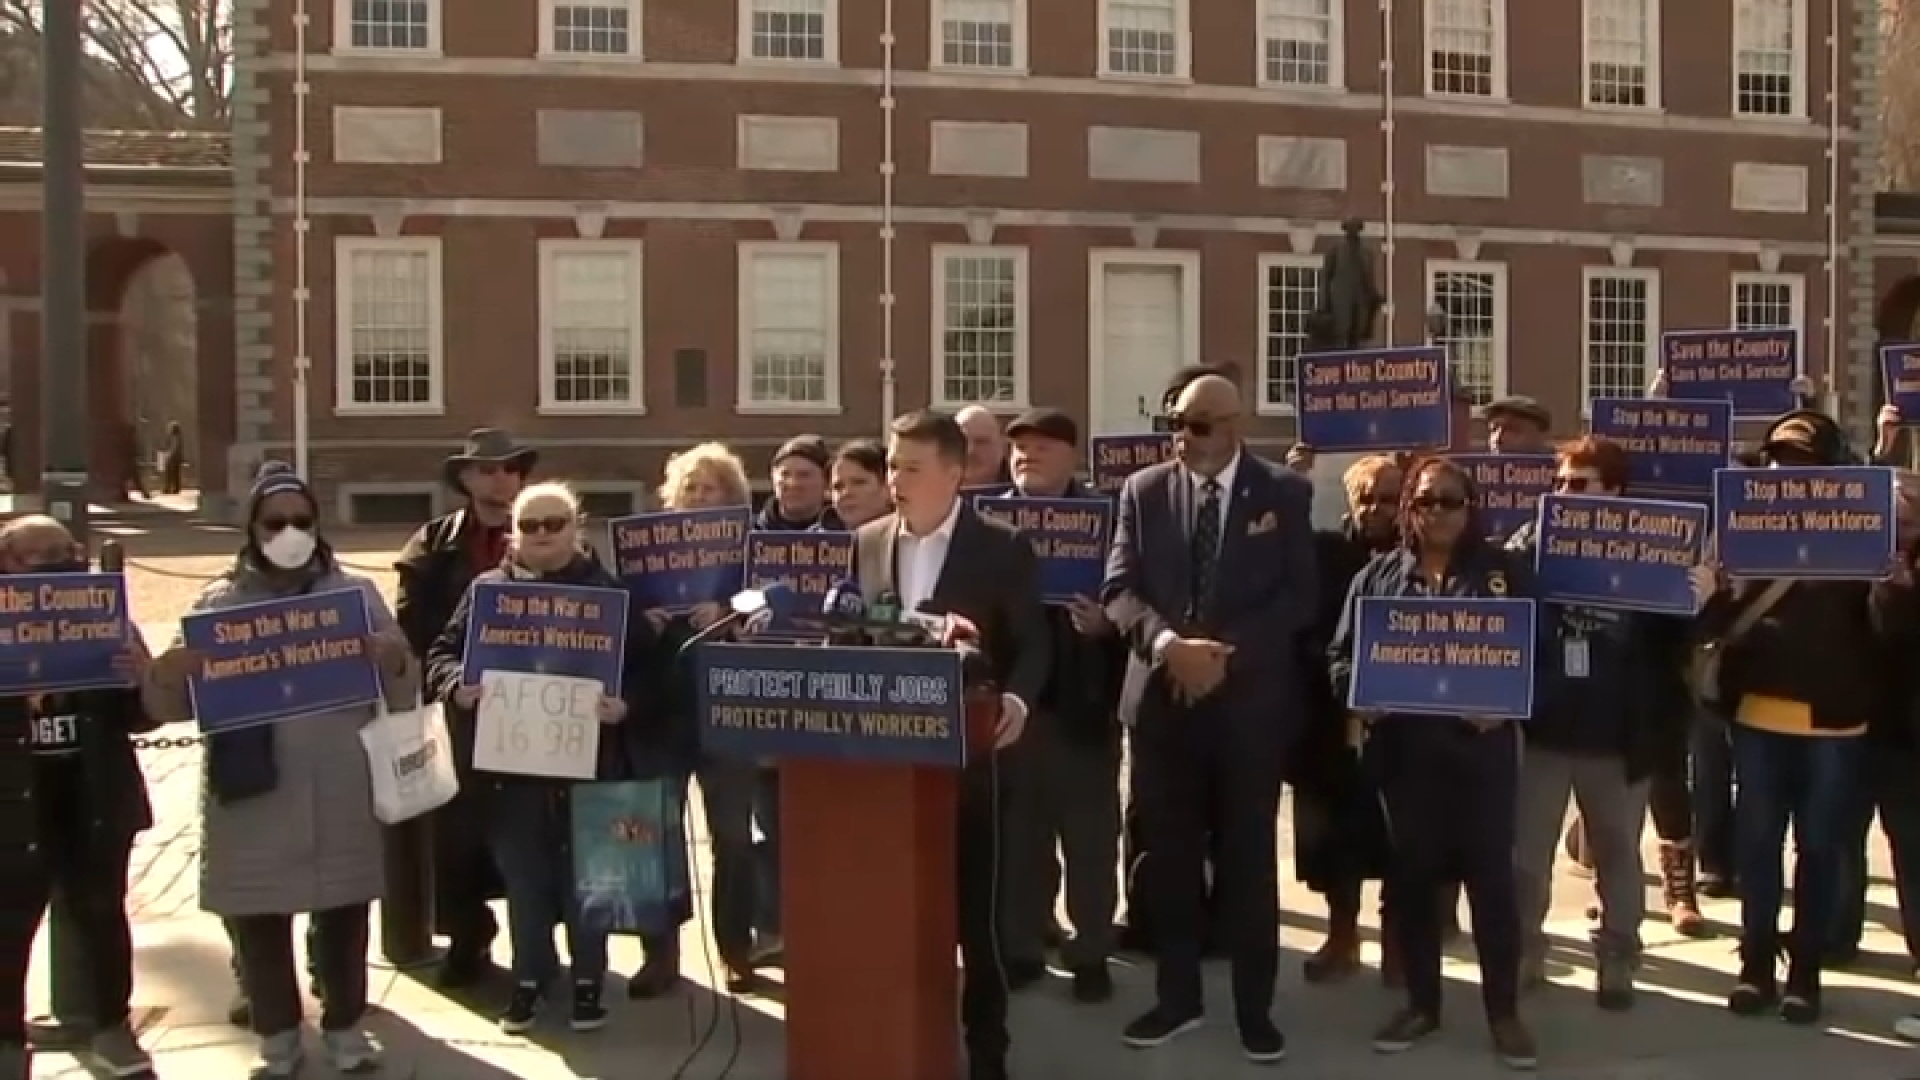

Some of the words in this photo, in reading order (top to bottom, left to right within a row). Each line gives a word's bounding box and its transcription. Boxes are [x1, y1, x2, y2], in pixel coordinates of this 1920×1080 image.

[1671, 340, 1702, 360] Save
[1706, 340, 1728, 358] the
[1732, 338, 1789, 360] Country
[1305, 362, 1340, 385] Save
[1346, 360, 1371, 382] the
[1375, 358, 1438, 383] Country
[1305, 393, 1332, 412] Save
[1336, 392, 1355, 410] the
[1359, 391, 1388, 408] Civil
[1389, 387, 1440, 408] Service!
[1612, 406, 1638, 428] Stop
[1642, 409, 1662, 427] the
[1666, 409, 1688, 427] War
[1692, 413, 1708, 428] on
[1099, 442, 1131, 464] Save
[1135, 443, 1157, 462] the
[1659, 436, 1721, 454] Workforce
[1476, 462, 1499, 484] the
[1743, 479, 1777, 503] Stop
[1781, 479, 1805, 499] the
[1810, 479, 1840, 499] War
[1845, 482, 1864, 499] on
[1017, 508, 1040, 529] the
[1043, 507, 1101, 538] Country
[1551, 503, 1589, 529] Save
[1596, 507, 1623, 531] the
[1628, 509, 1697, 544] Country
[1728, 509, 1797, 531] America's
[1803, 509, 1882, 531] Workforce
[619, 525, 649, 549] Save
[653, 522, 678, 544] the
[682, 518, 743, 544] Country
[668, 550, 696, 570] Civil
[699, 547, 743, 568] Service
[754, 541, 787, 565] Save
[792, 541, 814, 565] the
[1547, 535, 1577, 556] Save
[1581, 537, 1603, 558] the
[1607, 539, 1635, 561] Civil
[1639, 543, 1693, 568] Service!
[802, 573, 827, 593] Civil
[40, 584, 115, 614] Country
[496, 594, 522, 618] Stop
[527, 596, 549, 616] the
[552, 597, 580, 618] War
[583, 602, 599, 620] on
[18, 621, 54, 643] Civil
[58, 617, 121, 642] Service!
[213, 619, 252, 646] Stop
[256, 613, 282, 636] the
[285, 609, 316, 633] War
[320, 606, 339, 626] on
[1388, 609, 1421, 635] Stop
[1425, 609, 1448, 632] the
[1452, 608, 1482, 632] War
[1487, 615, 1505, 632] on
[480, 624, 539, 647] America's
[543, 626, 612, 651] Workforce
[203, 649, 280, 681] America's
[283, 634, 362, 666] Workforce
[1371, 641, 1441, 665] America's
[1445, 642, 1520, 667] Workforce
[484, 676, 591, 719] AFGE
[709, 667, 803, 698] PROTECT
[807, 671, 883, 701] PHILLY
[888, 674, 948, 705] JOBS
[711, 703, 788, 730] PROTECT
[794, 708, 853, 734] PHILLY
[858, 711, 949, 739] WORKERS
